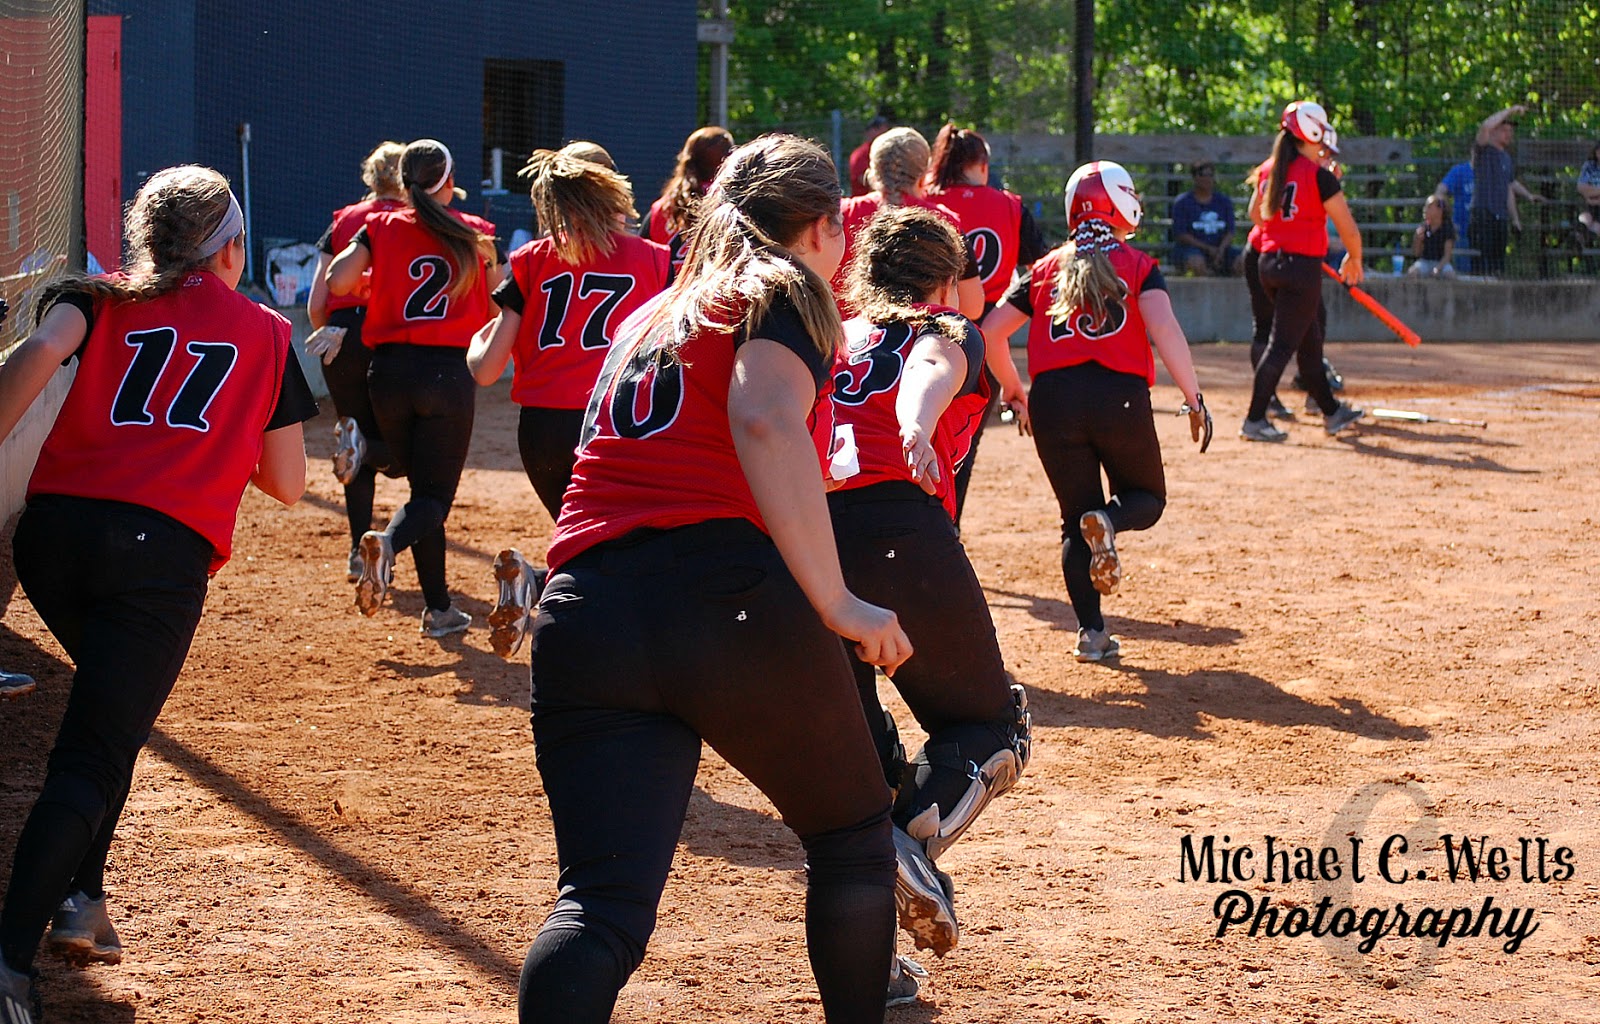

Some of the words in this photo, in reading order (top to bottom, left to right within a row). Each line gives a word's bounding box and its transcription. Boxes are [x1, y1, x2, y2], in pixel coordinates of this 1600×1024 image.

[1081, 201, 1094, 213] 13
[403, 254, 452, 321] 2
[538, 271, 636, 350] 17
[110, 326, 239, 433] 11
